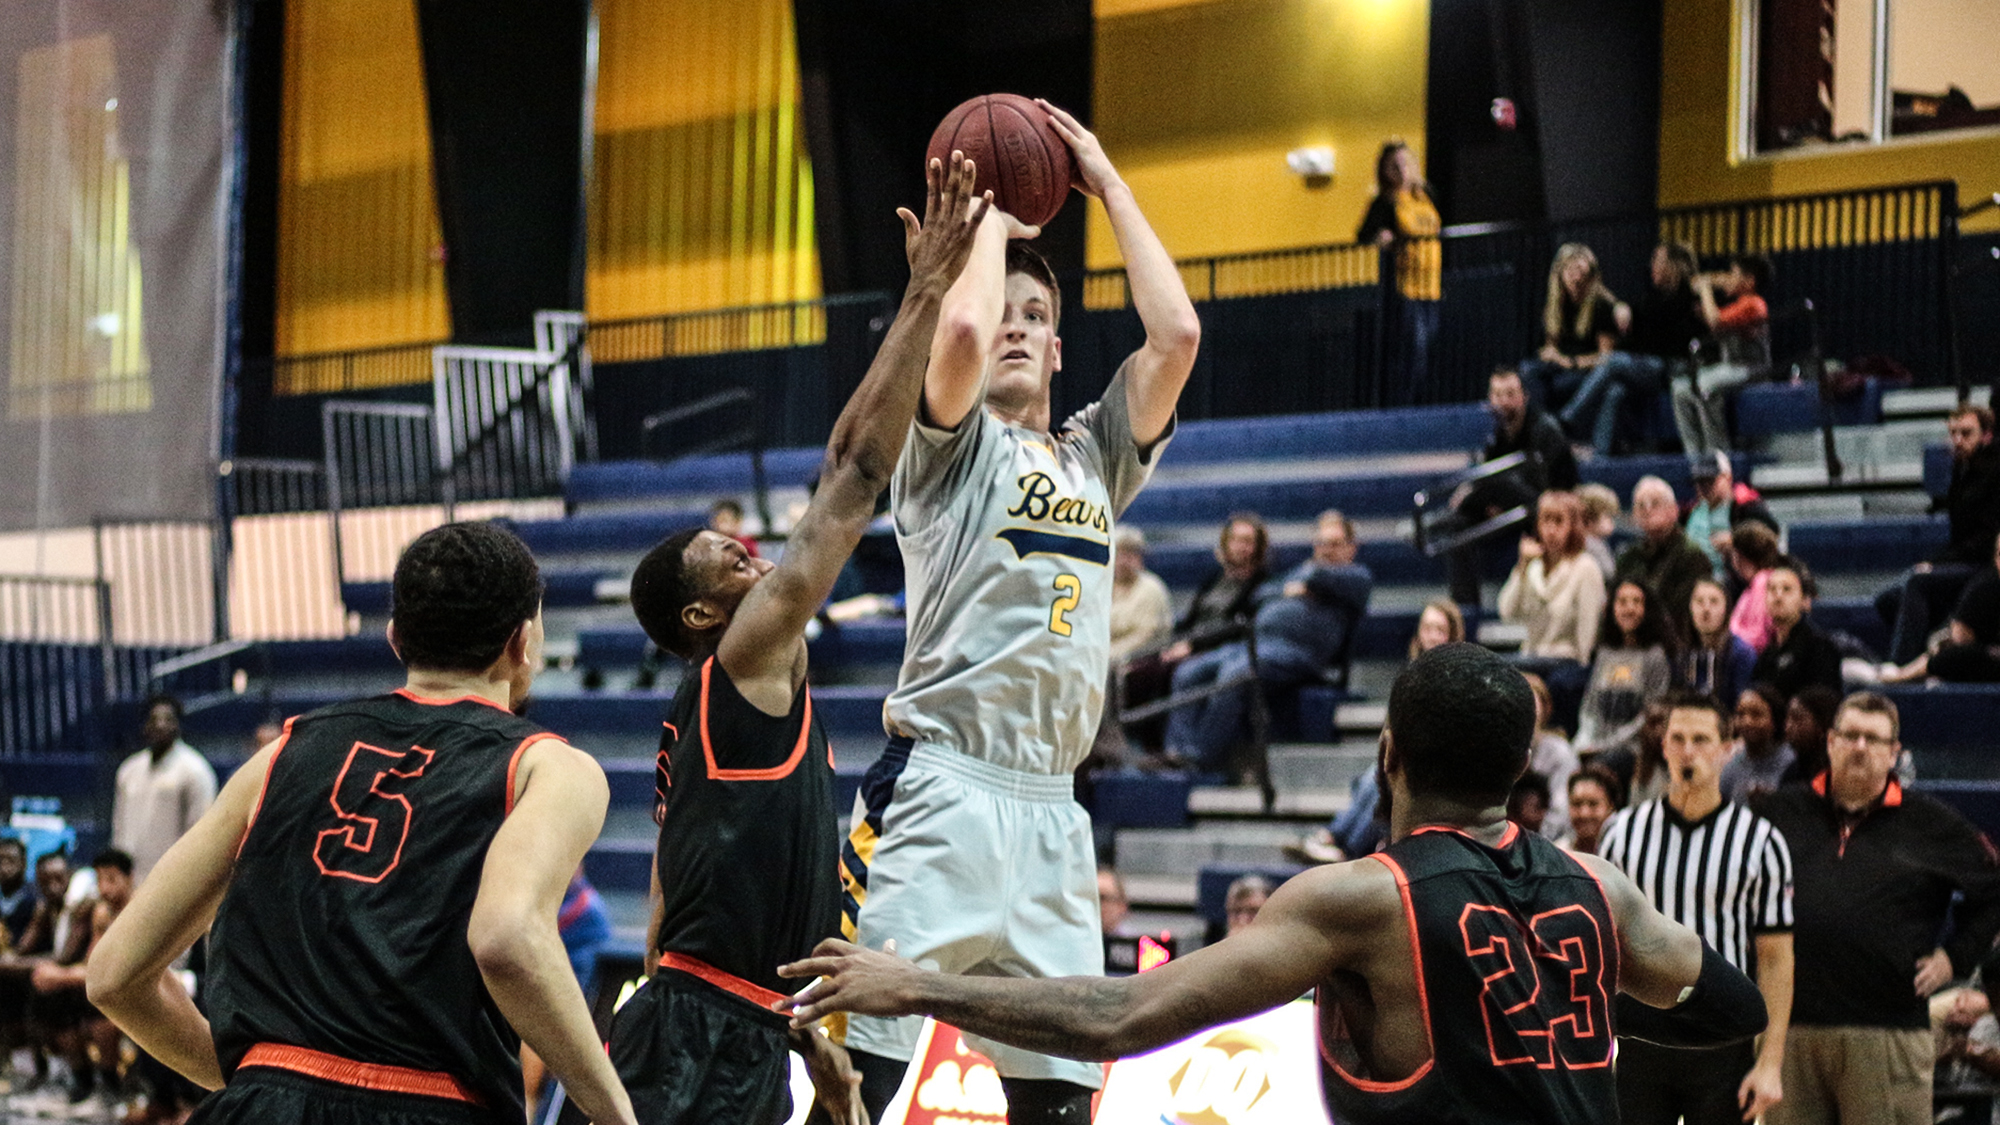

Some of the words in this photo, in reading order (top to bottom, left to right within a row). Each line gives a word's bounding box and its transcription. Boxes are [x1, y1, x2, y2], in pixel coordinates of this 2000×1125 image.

[1007, 471, 1108, 534] Bears
[1048, 573, 1082, 637] 2
[312, 741, 436, 883] 5
[1458, 903, 1614, 1070] 23
